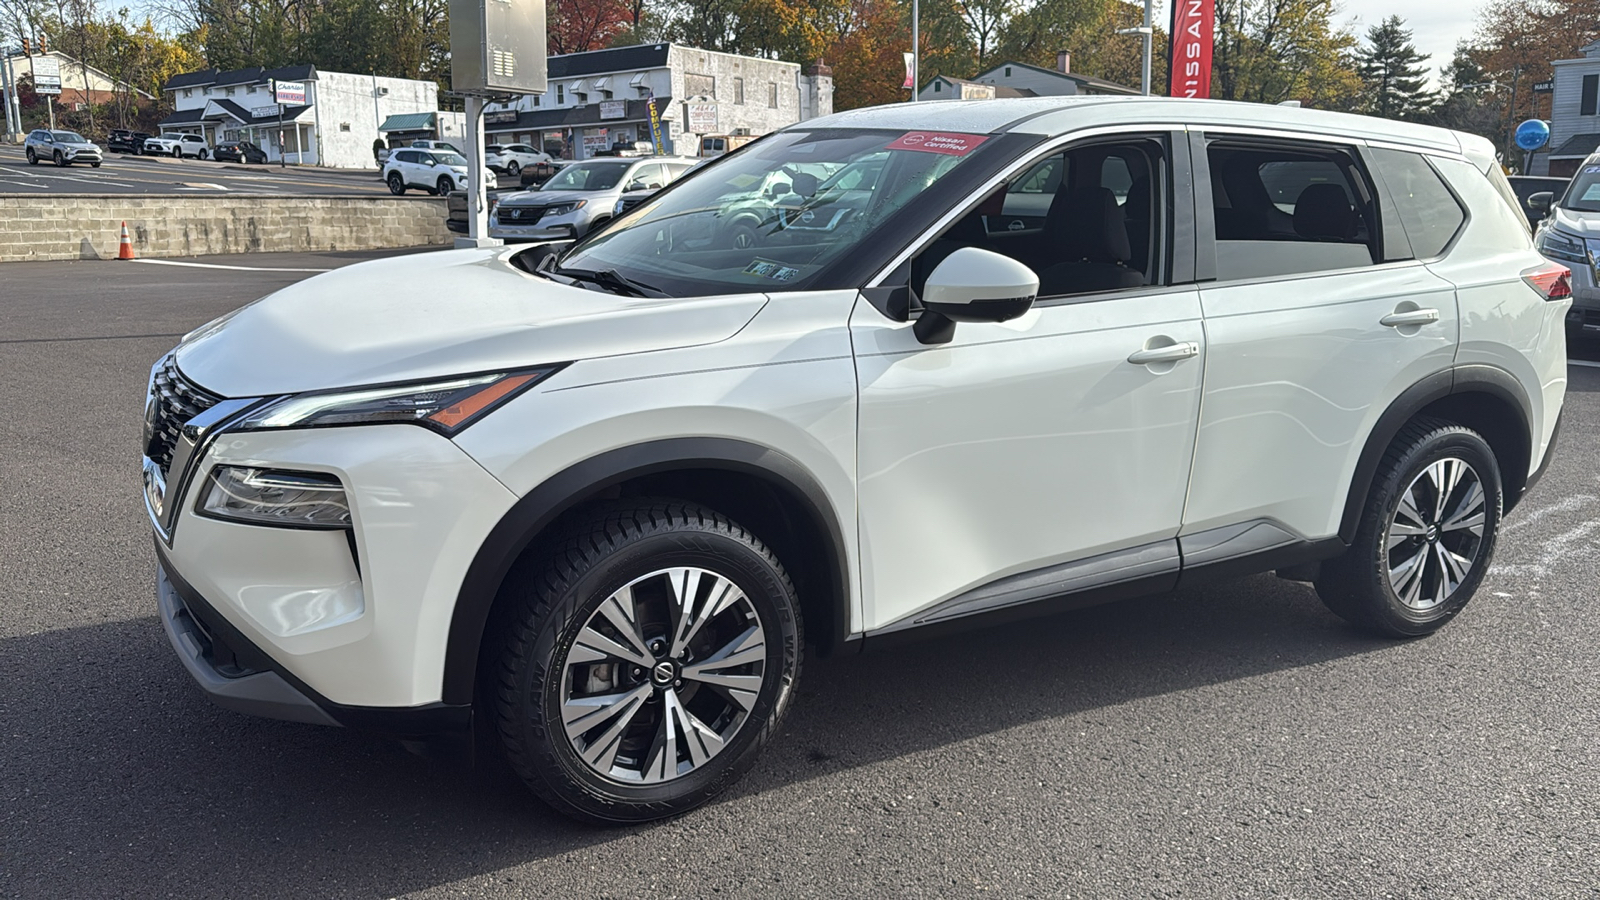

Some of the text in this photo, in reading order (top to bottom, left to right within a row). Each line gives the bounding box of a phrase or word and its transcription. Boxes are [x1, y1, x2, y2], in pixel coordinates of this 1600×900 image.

[690, 111, 716, 119] COMPUTERS
[584, 136, 607, 145] COMPUTERS
[924, 142, 967, 151] Certified
